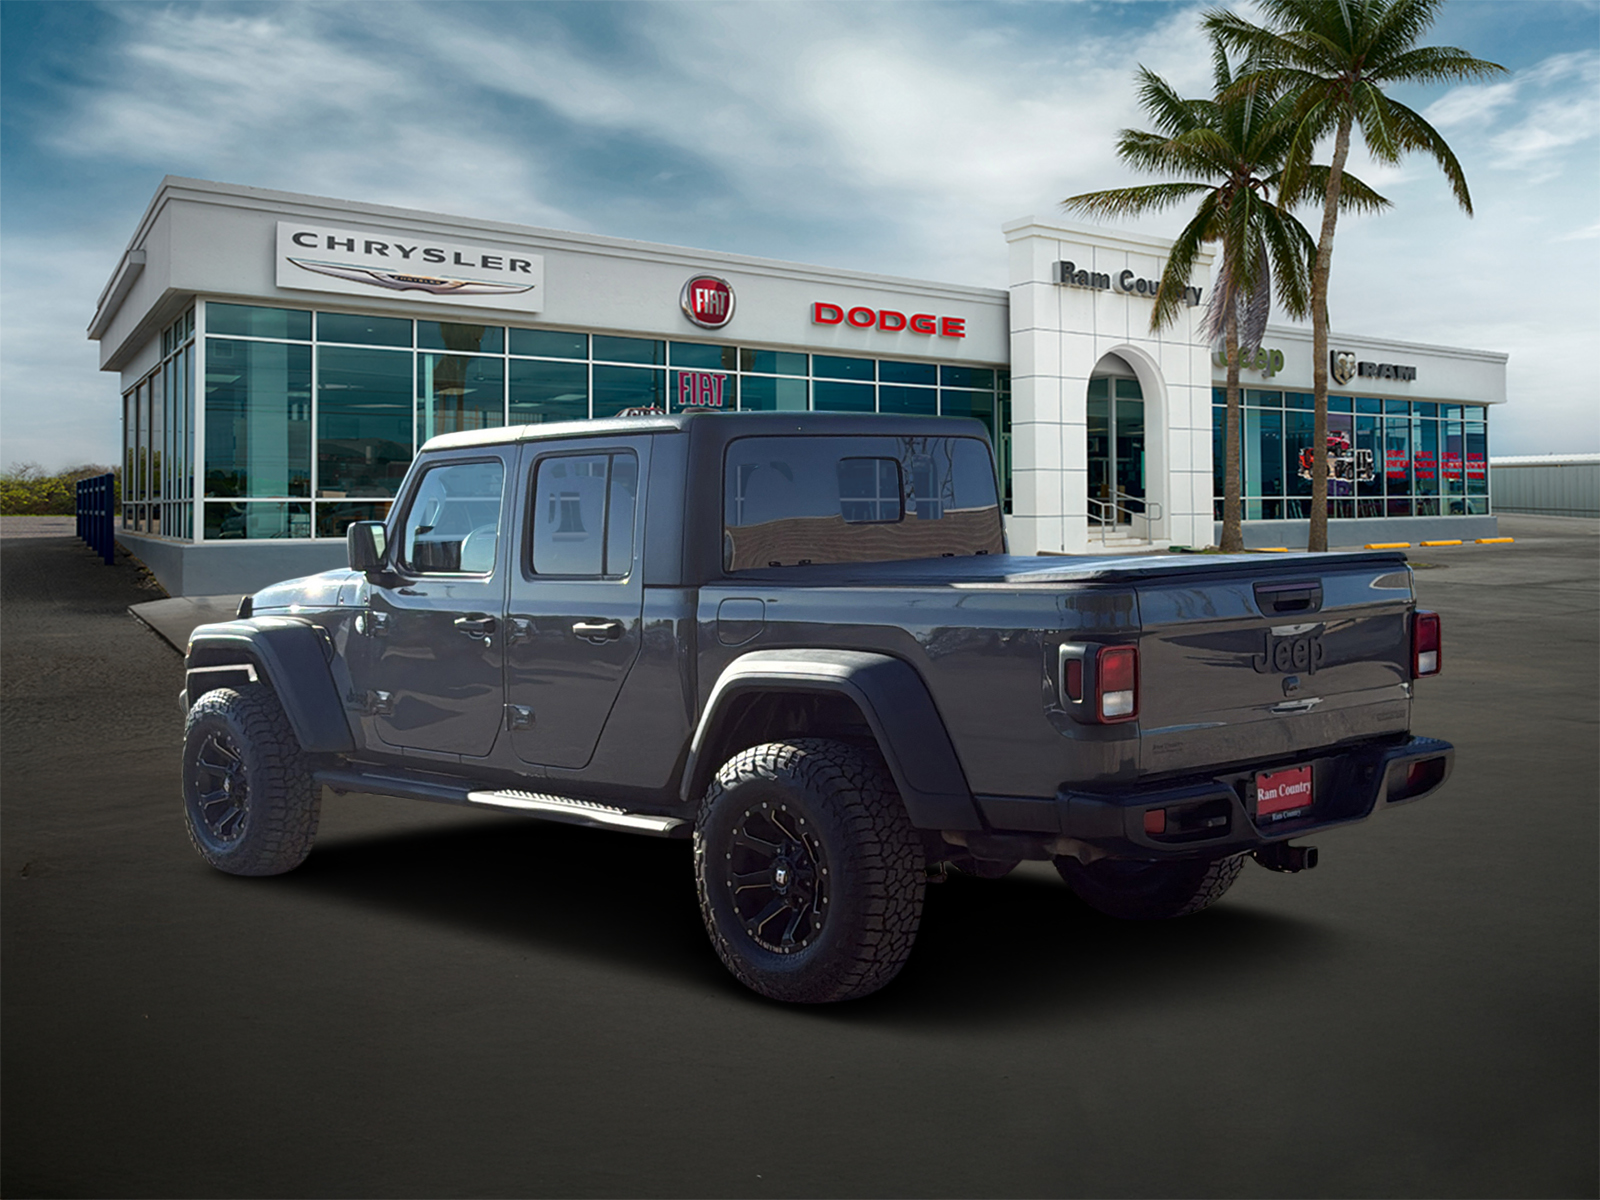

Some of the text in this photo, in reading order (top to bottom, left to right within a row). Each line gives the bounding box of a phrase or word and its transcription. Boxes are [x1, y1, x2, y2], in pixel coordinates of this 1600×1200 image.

[291, 231, 533, 275] CHRYSLER
[1053, 260, 1203, 307] Ram Coury
[695, 287, 728, 317] FIAT
[811, 301, 966, 338] DODGE
[677, 371, 727, 407] FIAT
[1358, 361, 1416, 381] RAM
[1252, 632, 1323, 676] Jeep
[1257, 781, 1312, 802] Ram Country
